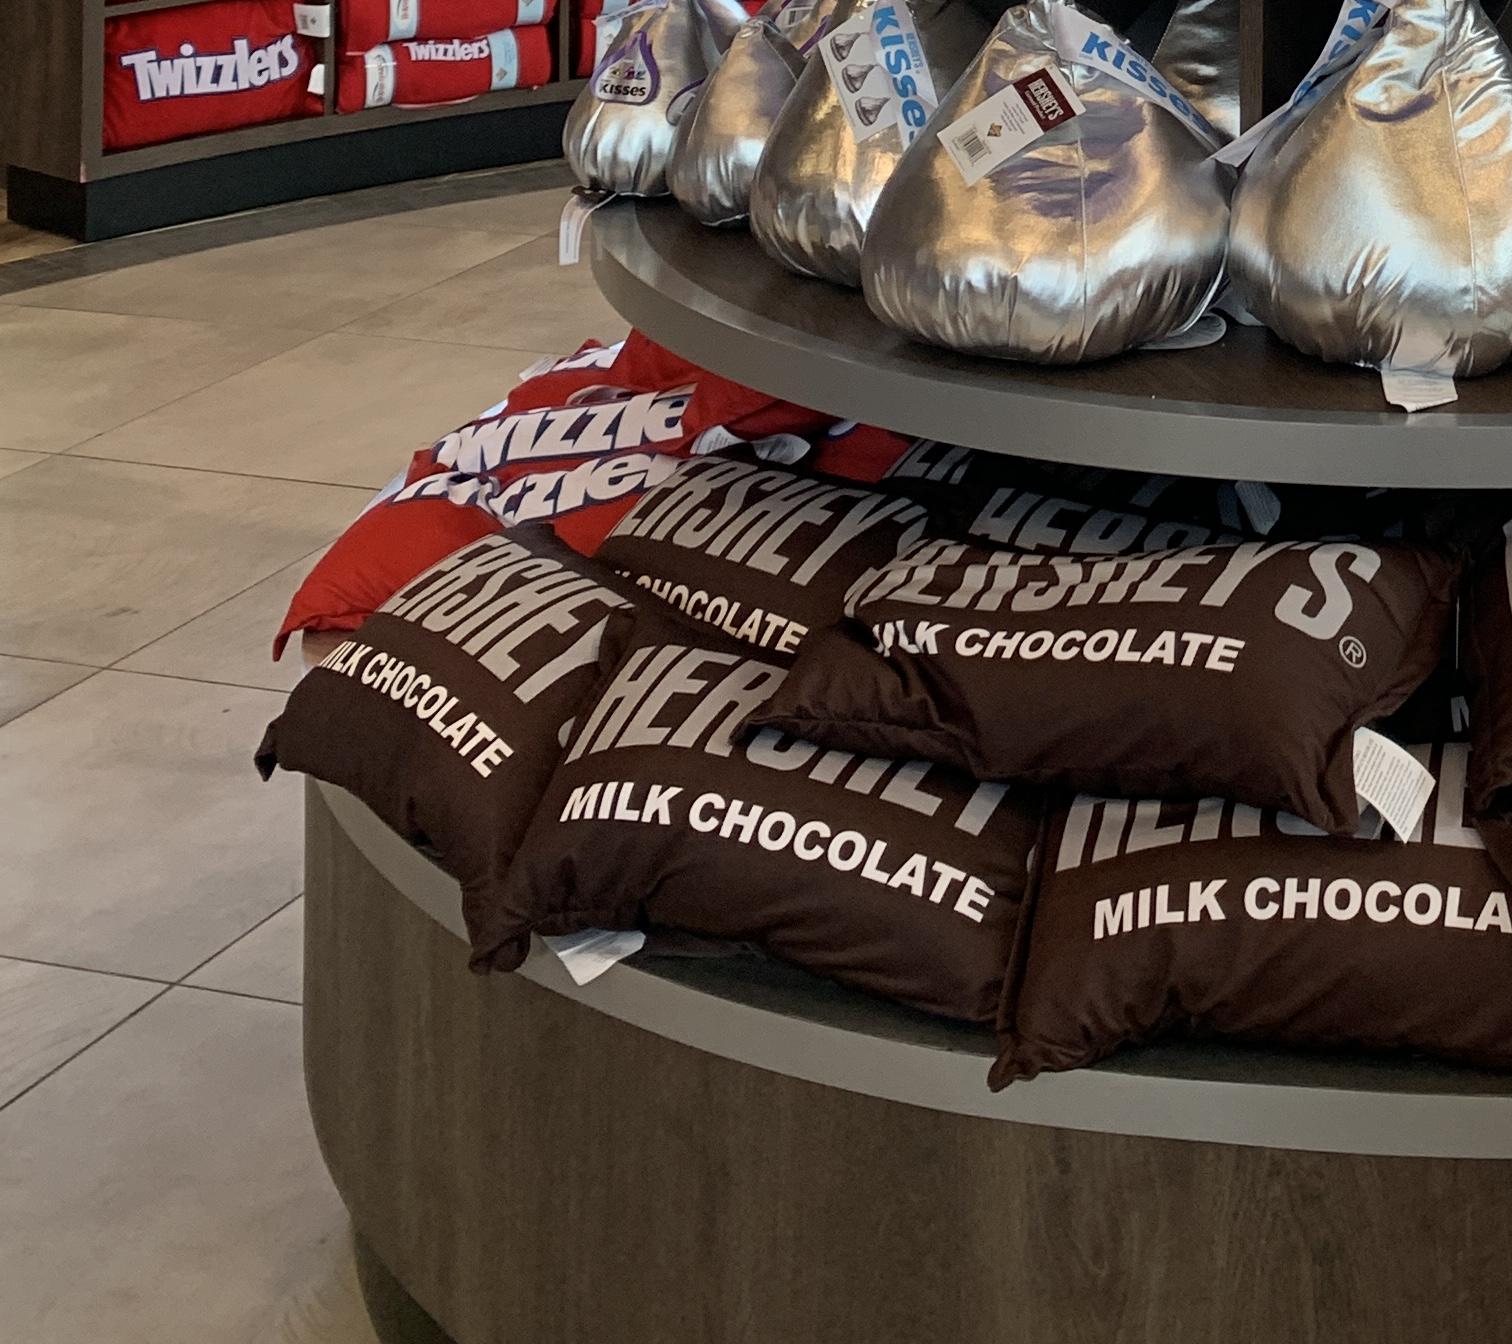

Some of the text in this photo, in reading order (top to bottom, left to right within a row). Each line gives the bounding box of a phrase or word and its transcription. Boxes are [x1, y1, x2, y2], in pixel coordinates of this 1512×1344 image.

[121, 34, 299, 101] Twizzlers
[403, 38, 491, 62] Twizzlers
[875, 6, 926, 143] KISSE
[1027, 77, 1064, 121] HERSHEY'S
[955, 625, 1247, 673] CHOCOLATE
[360, 652, 515, 779] CHOCOLATE
[559, 780, 685, 826] MILK
[688, 792, 996, 924] CHOCOLATE
[1092, 878, 1228, 941] MILK
